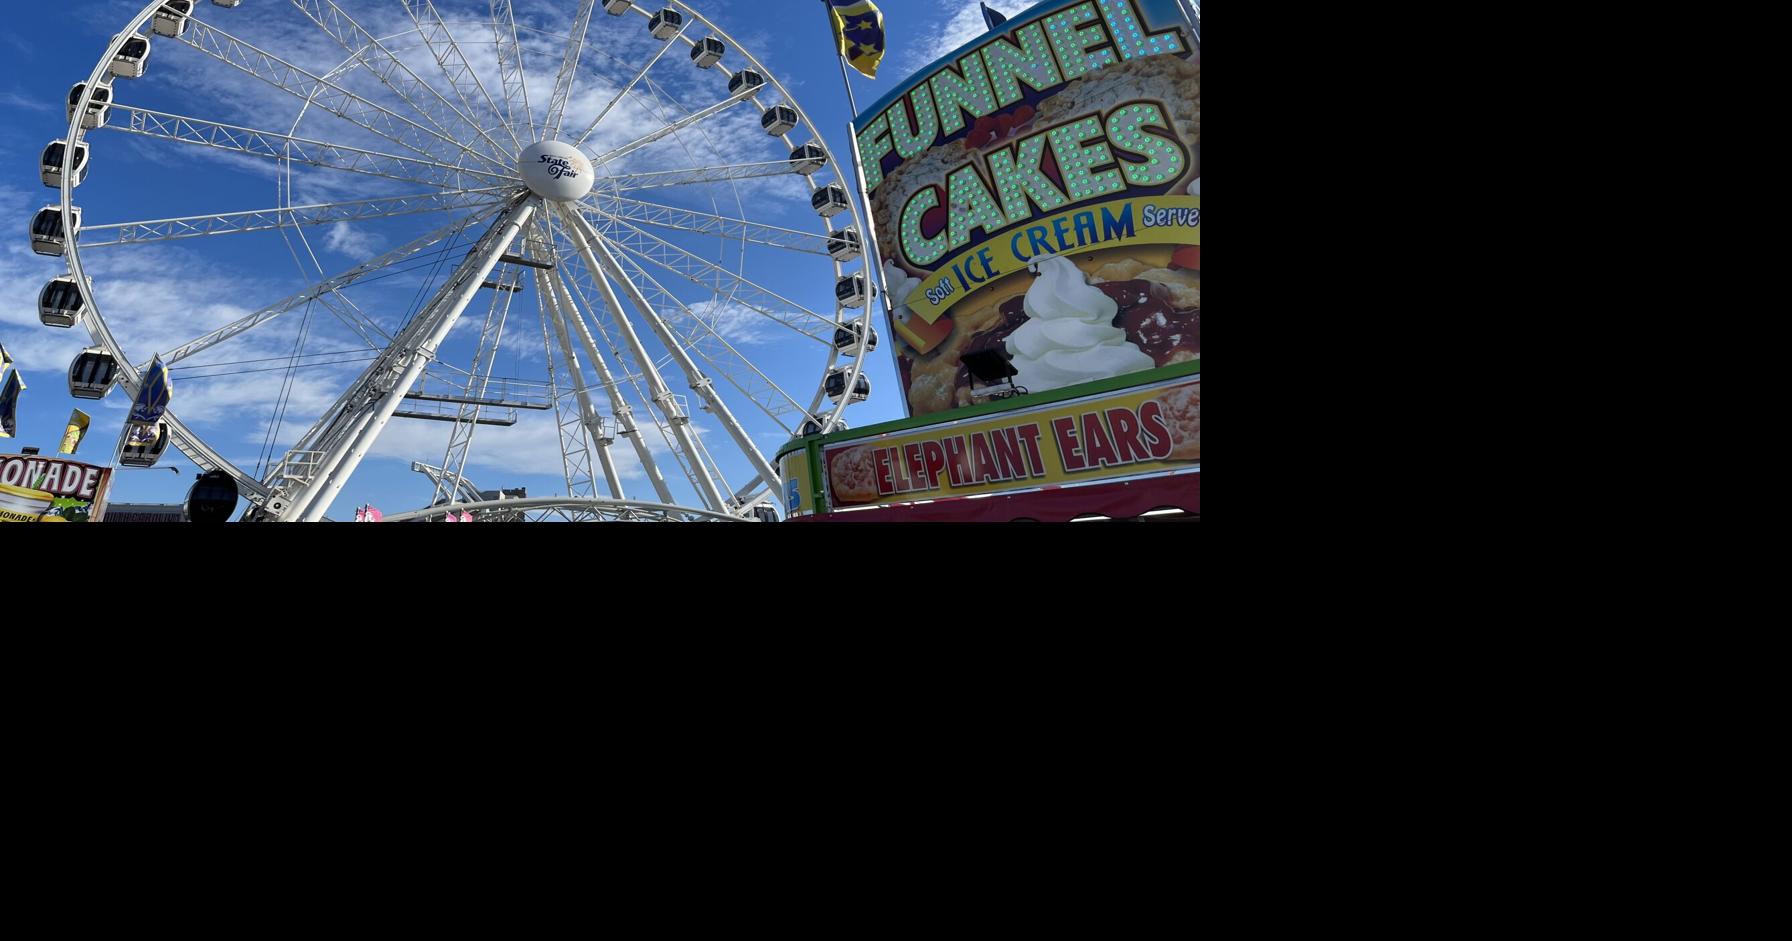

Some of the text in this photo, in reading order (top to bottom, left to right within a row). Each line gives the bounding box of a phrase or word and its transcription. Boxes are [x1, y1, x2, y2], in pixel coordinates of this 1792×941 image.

[857, 0, 1190, 194] FUNNEL
[537, 154, 570, 168] State
[548, 164, 578, 180] Fair
[900, 101, 1188, 266] CAKES
[925, 202, 1200, 305] Soft ICE CREAM Serve
[0, 458, 99, 497] ONADE
[872, 399, 1173, 496] ELEPHANT EARS
